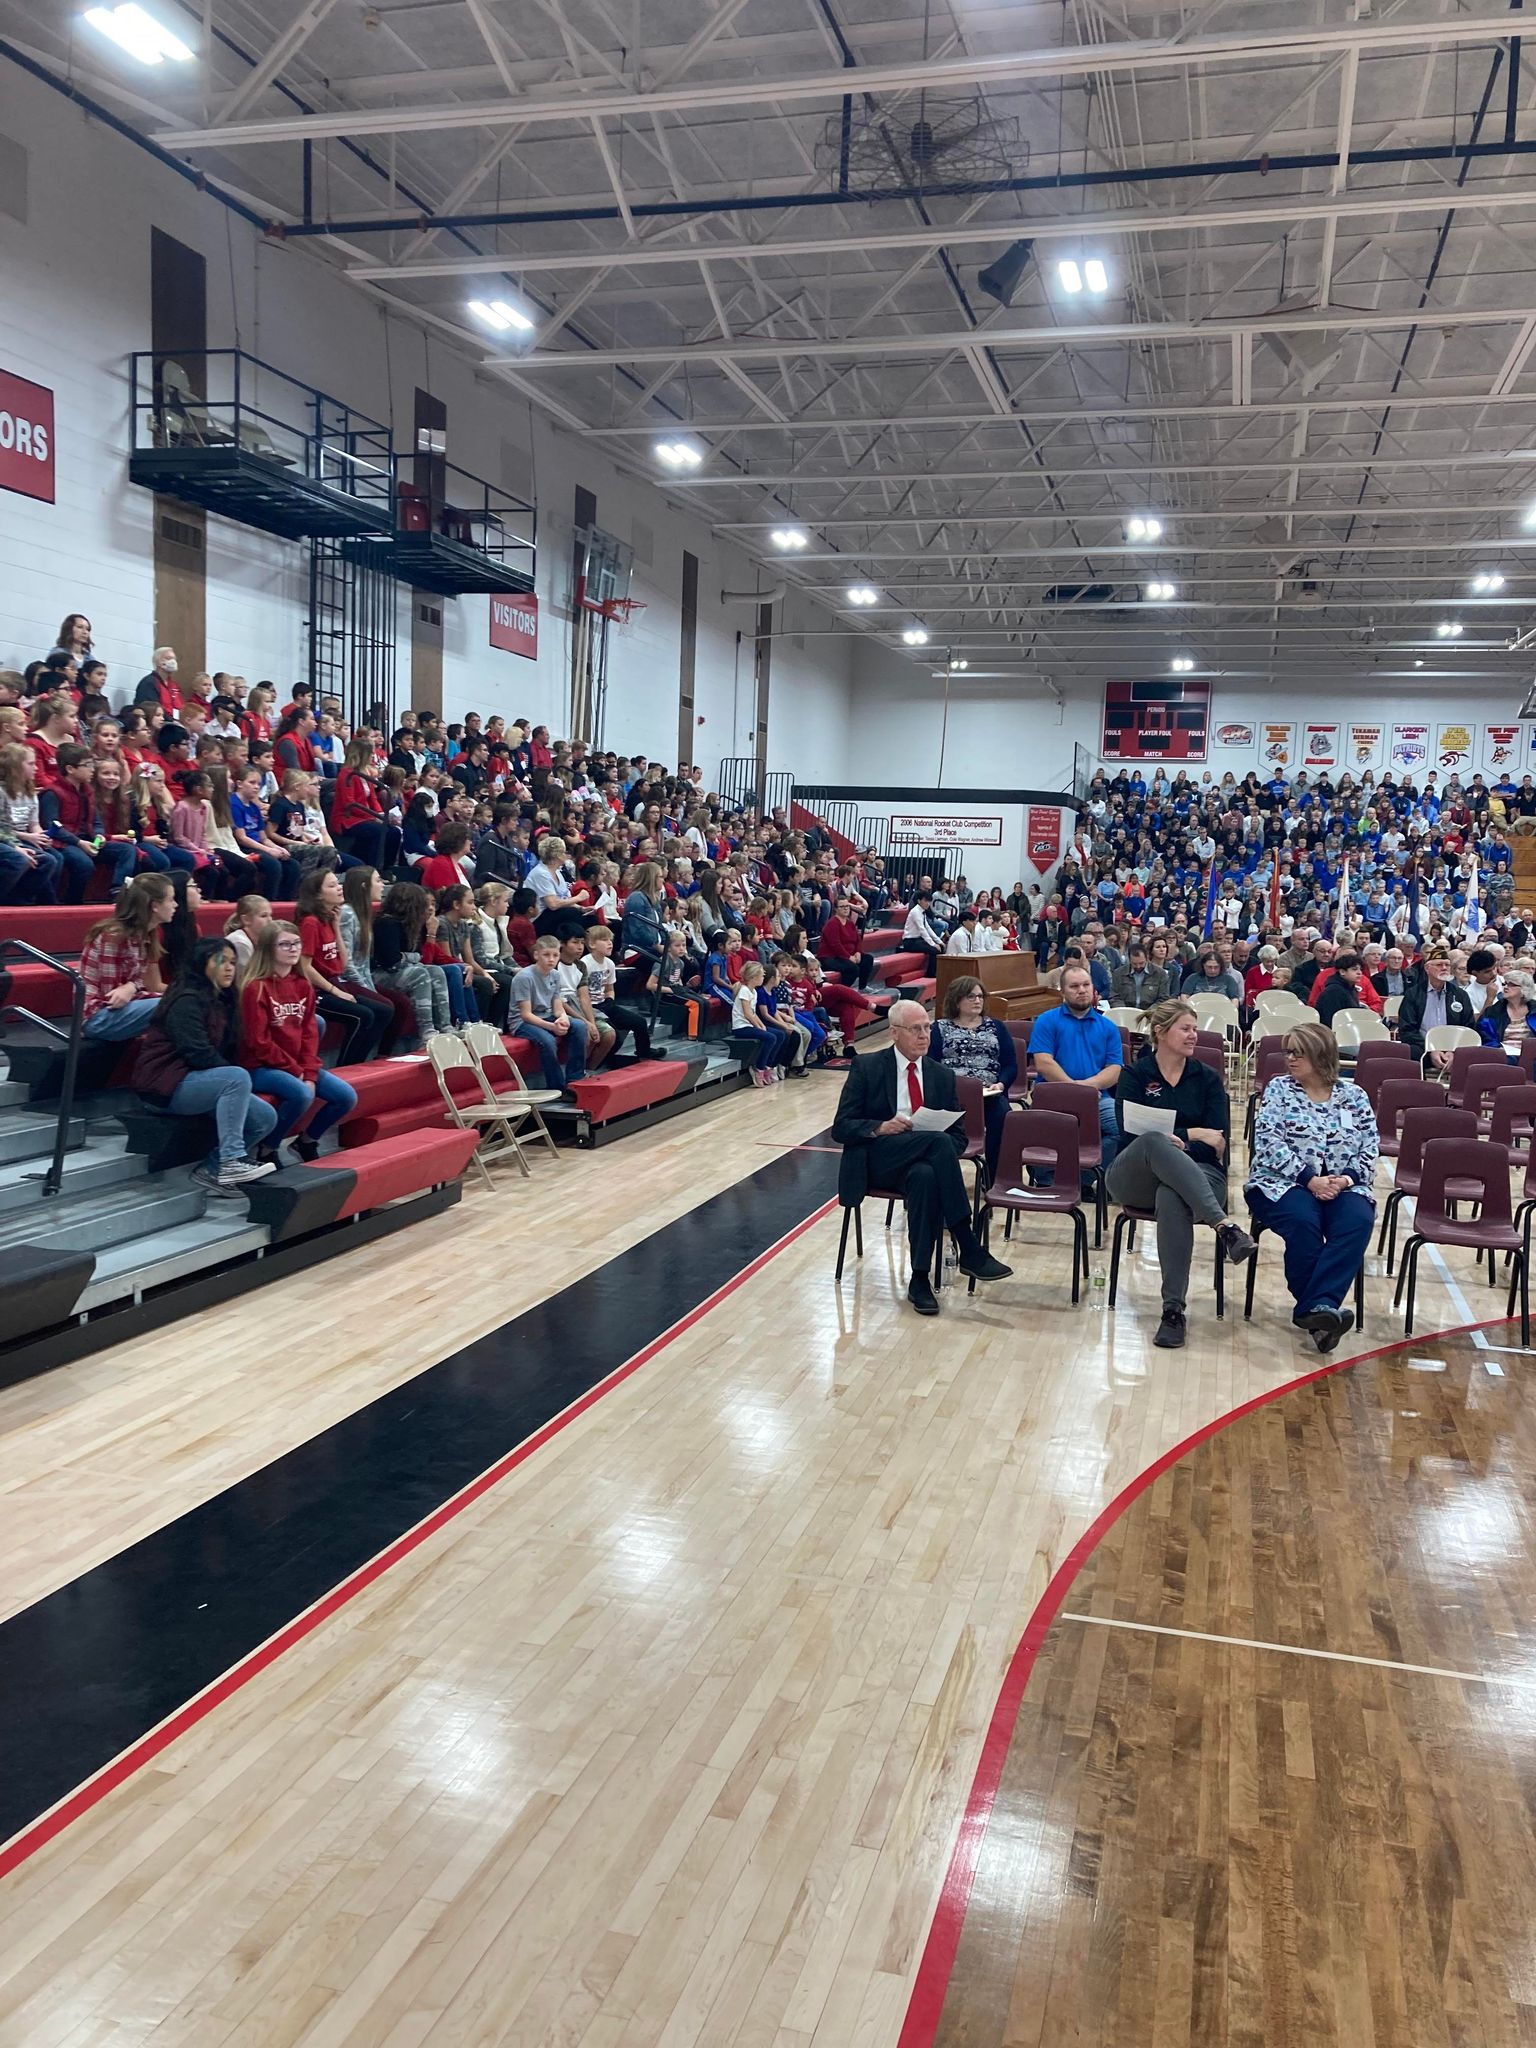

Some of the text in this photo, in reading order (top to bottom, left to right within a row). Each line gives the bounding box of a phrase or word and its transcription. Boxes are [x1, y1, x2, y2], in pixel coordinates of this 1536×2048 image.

[494, 601, 535, 636] VISITORS
[1393, 744, 1426, 759] PATRIOTS
[900, 819, 912, 827] 2006
[963, 820, 993, 829] Competition
